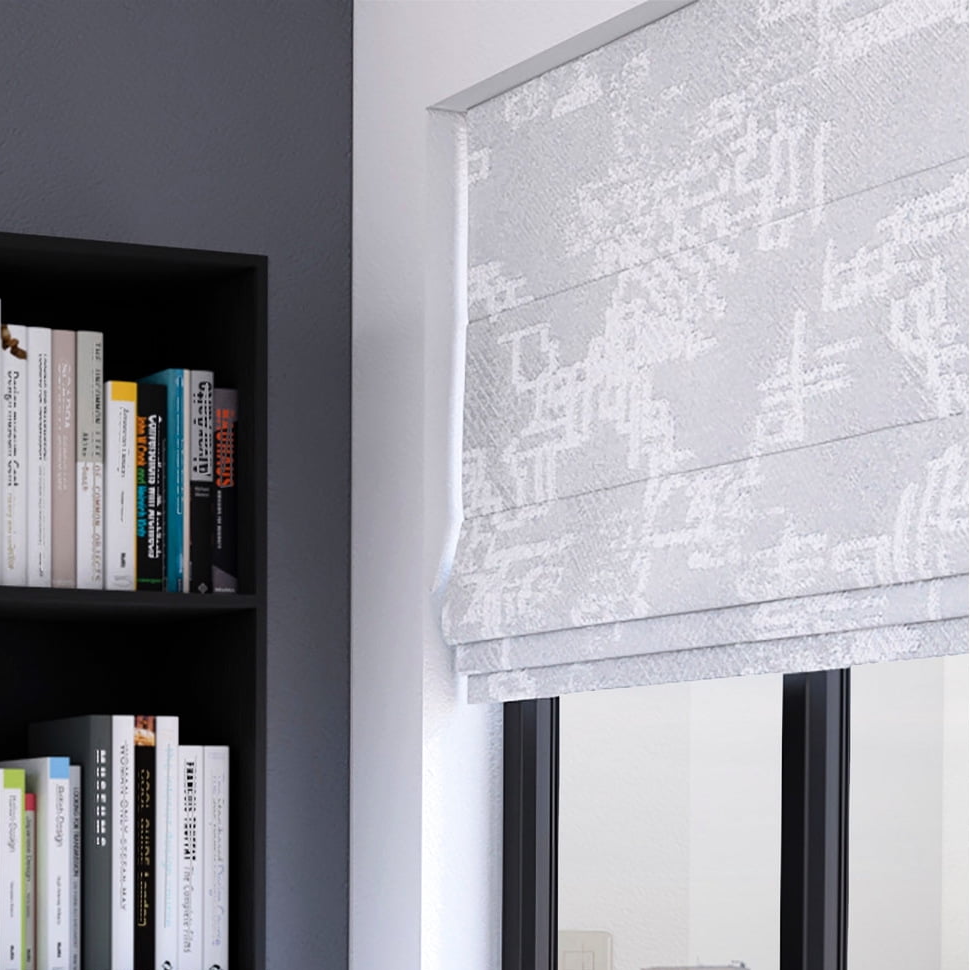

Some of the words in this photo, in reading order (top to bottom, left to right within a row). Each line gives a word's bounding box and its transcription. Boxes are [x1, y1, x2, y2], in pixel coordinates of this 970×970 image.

[92, 342, 102, 362] THE
[4, 370, 20, 408] Design
[92, 368, 102, 425] UNCOMMON
[8, 411, 17, 457] museum
[92, 431, 102, 458] LIFE
[147, 414, 162, 485] Conversations
[215, 407, 235, 488] BAUHAUS
[7, 460, 20, 487] Gent
[92, 465, 102, 477] OF
[92, 485, 102, 527] COMMON
[147, 486, 162, 508] with
[147, 509, 162, 559] Architects
[92, 532, 102, 583] OBJECTS
[119, 744, 130, 795] WOMAN
[137, 768, 151, 809] COOL
[54, 785, 66, 816] British
[93, 749, 107, 848] MUSEUMS
[119, 800, 130, 833] ONLY
[54, 817, 66, 848] Design
[137, 817, 151, 866] GUIDE
[119, 837, 130, 882] STEFAN
[182, 865, 194, 882] The
[119, 887, 130, 911] MAY
[137, 871, 151, 927] London
[182, 885, 194, 928] Complete
[182, 929, 194, 954] Films
